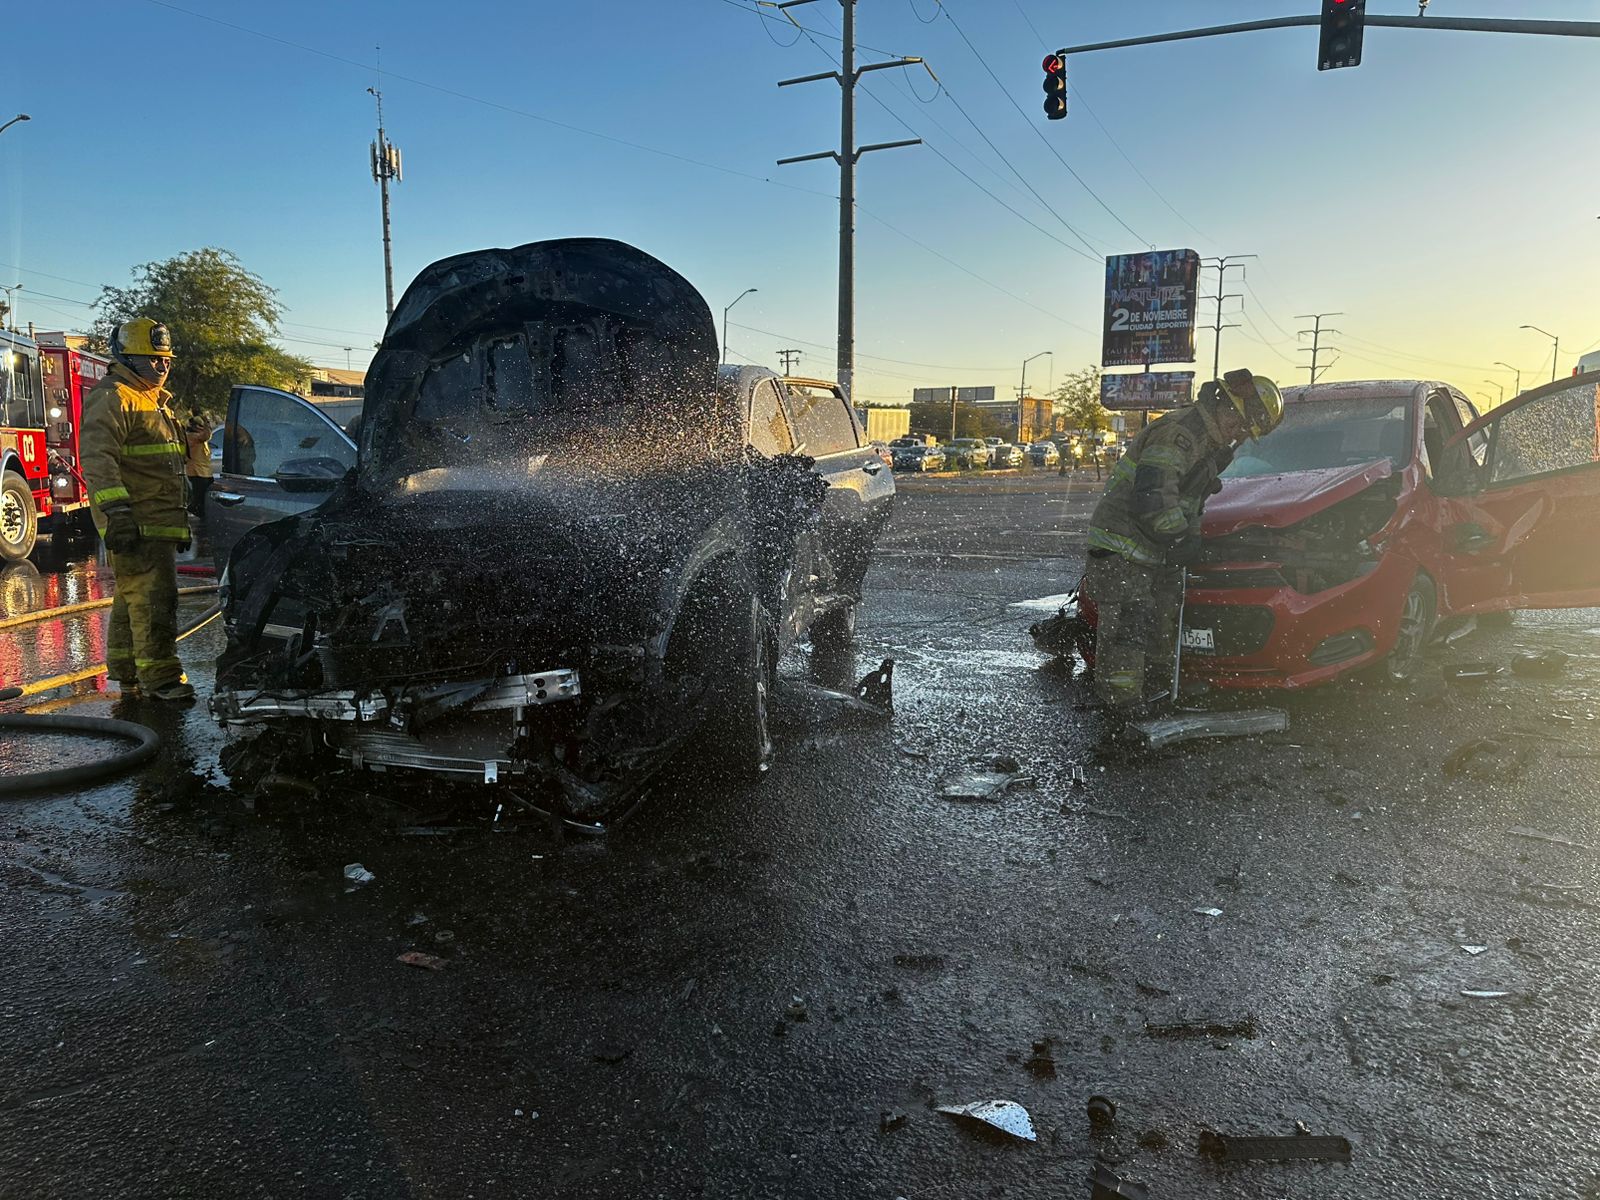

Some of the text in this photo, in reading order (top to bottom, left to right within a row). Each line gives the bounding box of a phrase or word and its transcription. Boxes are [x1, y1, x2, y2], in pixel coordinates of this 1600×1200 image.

[1111, 285, 1186, 306] MATUTE
[1111, 308, 1188, 331] 2 DE NOVIEMBRE
[1129, 323, 1154, 331] CIUDAD
[1106, 385, 1118, 397] 2
